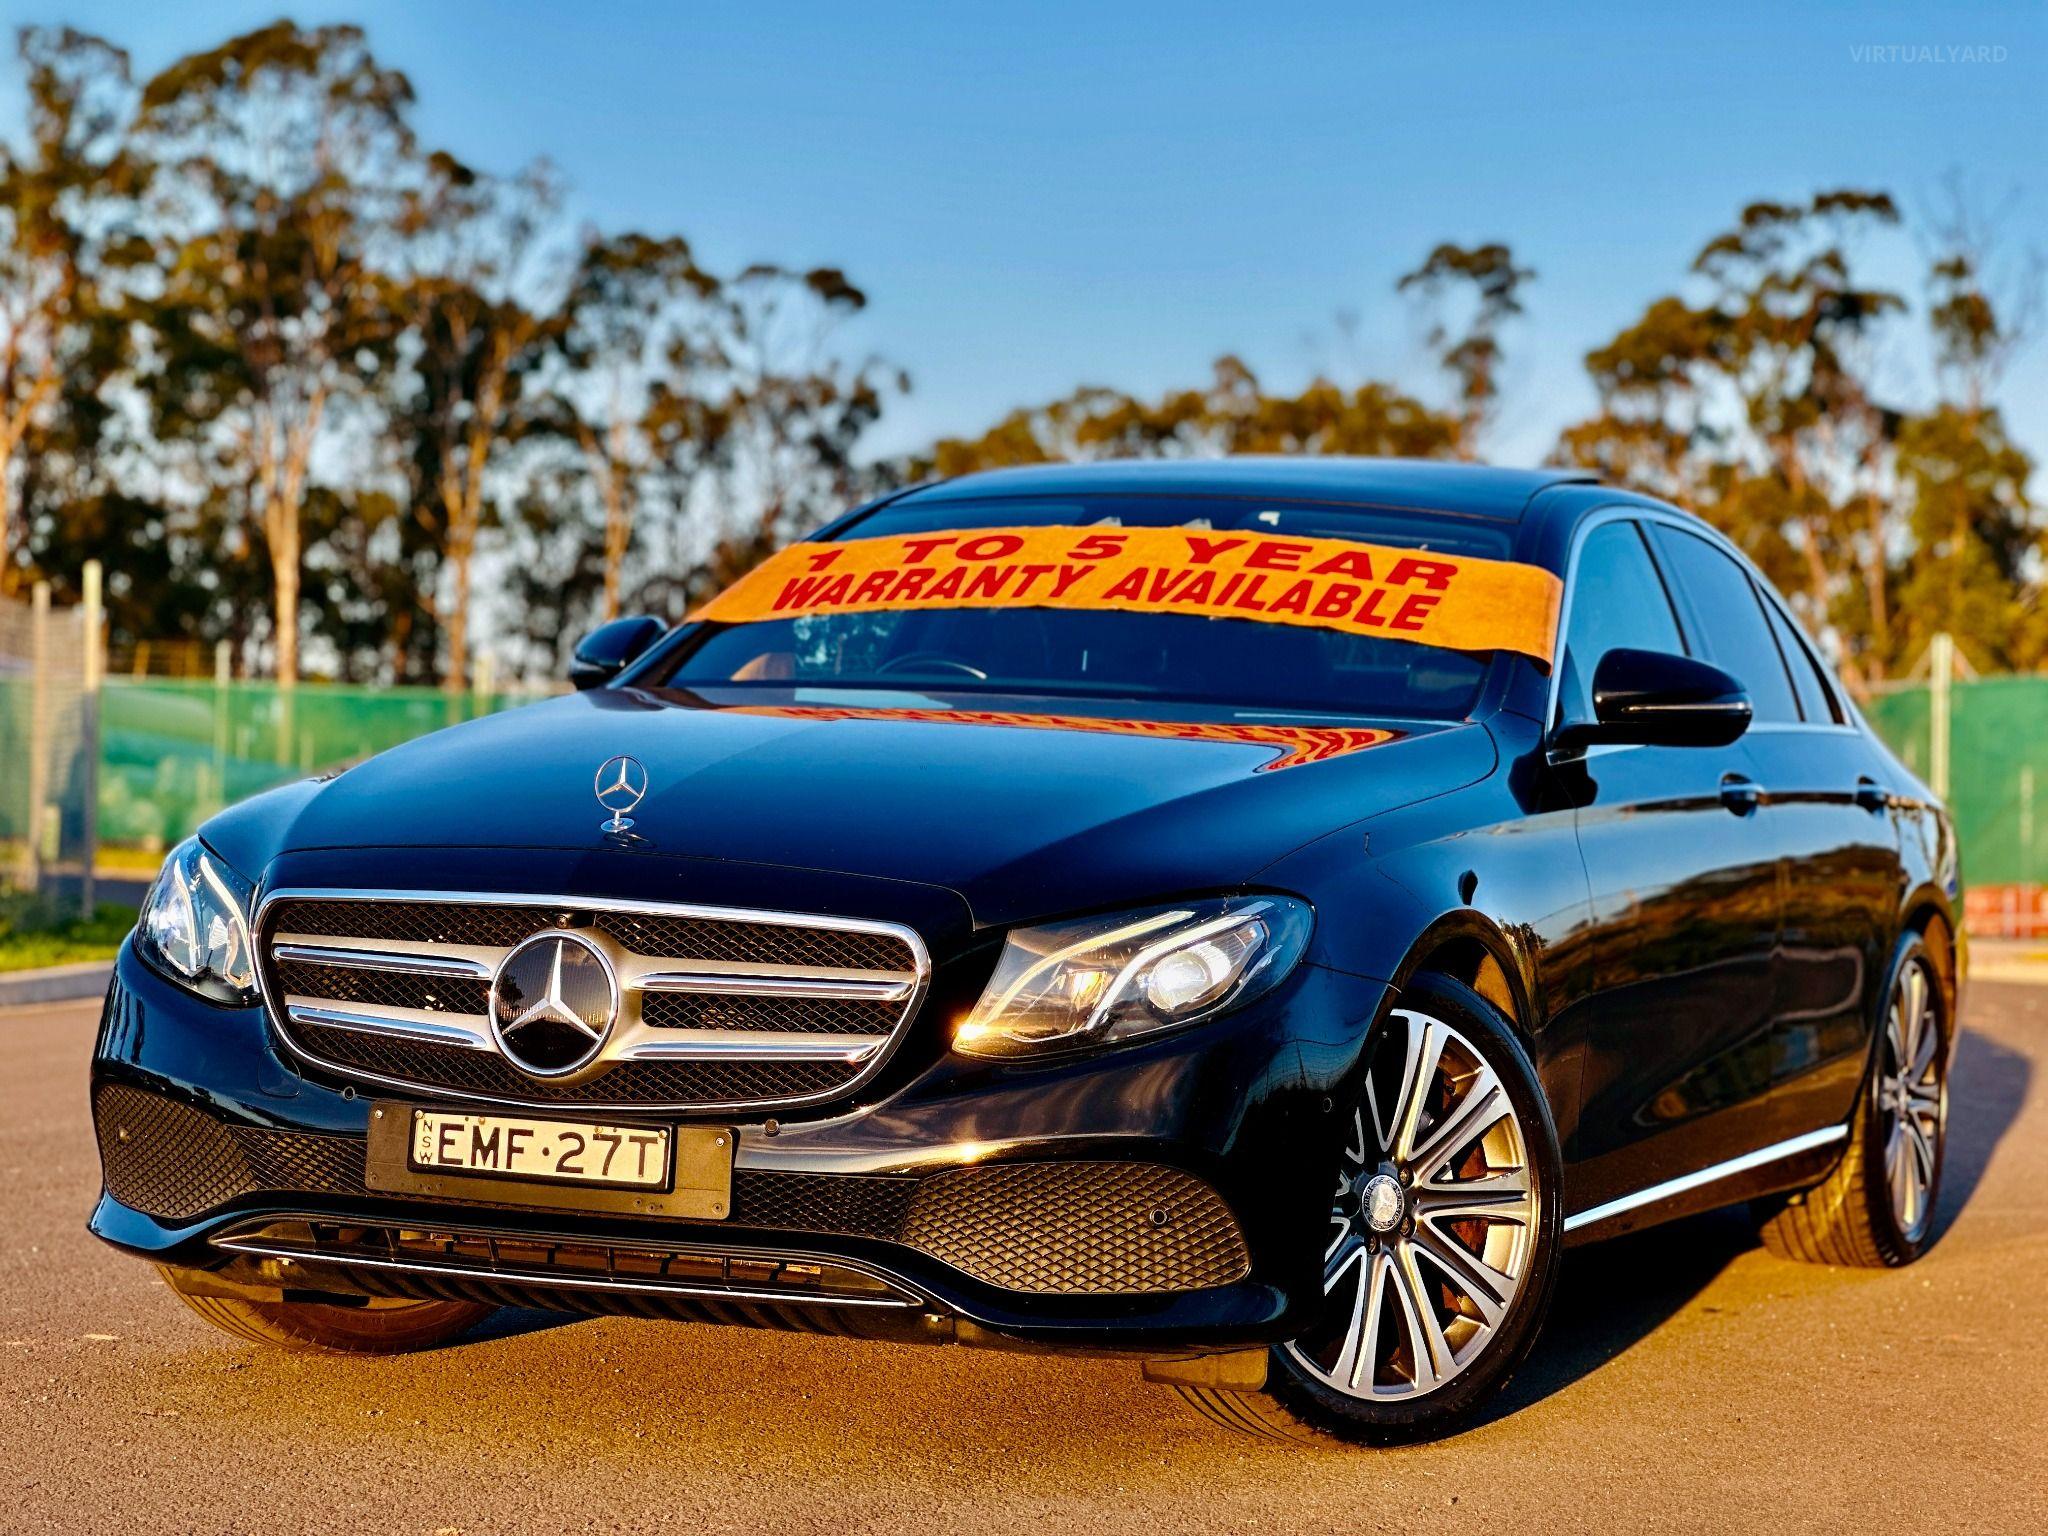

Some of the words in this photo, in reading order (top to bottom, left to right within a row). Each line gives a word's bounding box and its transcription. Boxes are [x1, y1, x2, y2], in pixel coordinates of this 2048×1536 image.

[808, 549, 845, 572] 1
[902, 535, 1024, 565] TO
[1066, 535, 1129, 560] 5
[1184, 537, 1459, 592] YEAR
[771, 564, 1097, 612] WARRANTY
[1101, 567, 1441, 631] AVAILABLE
